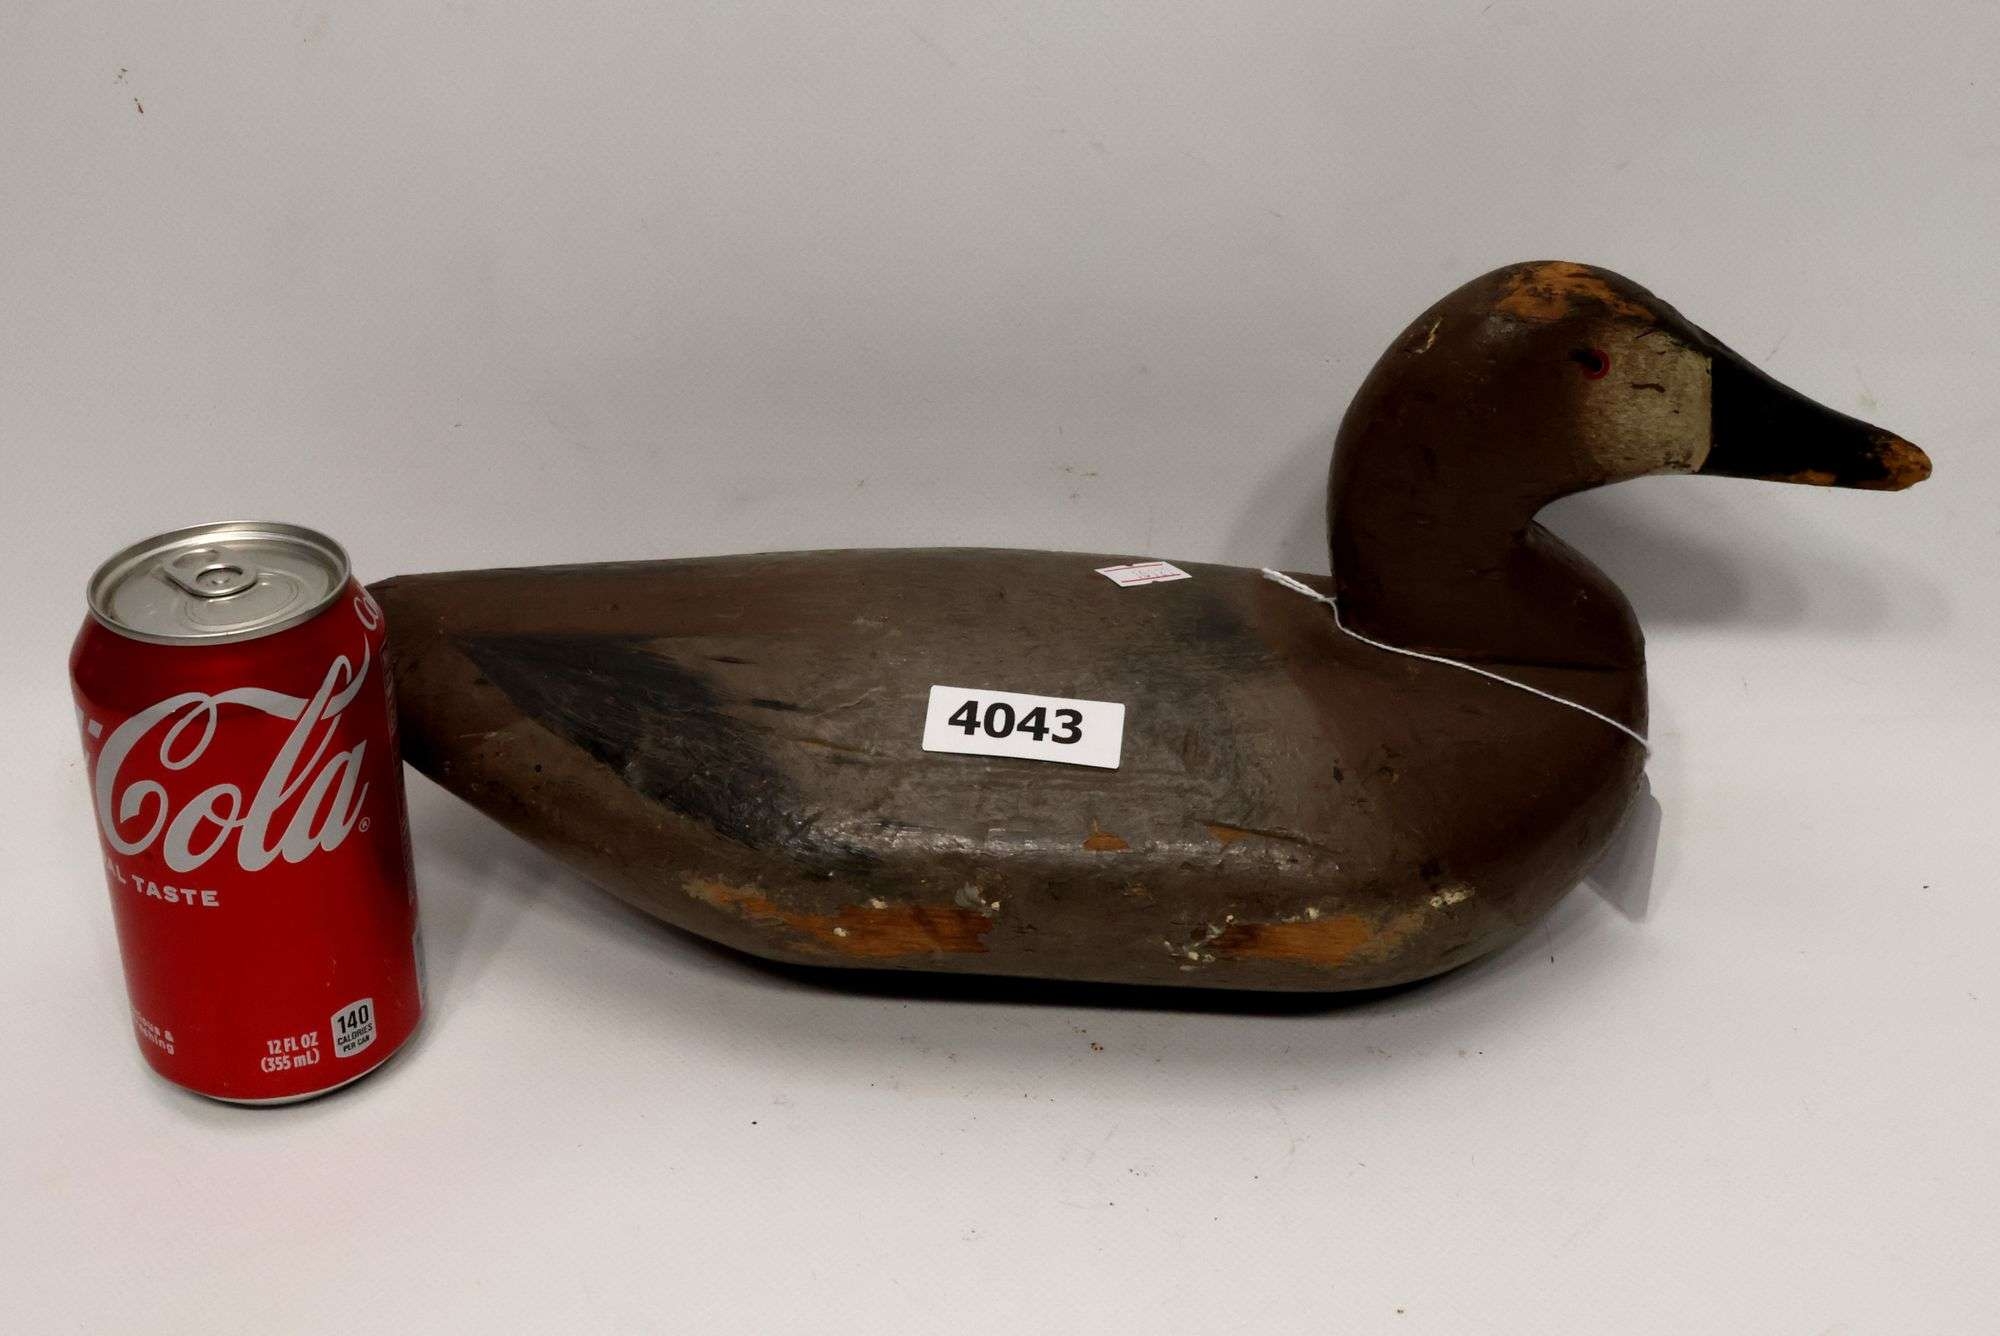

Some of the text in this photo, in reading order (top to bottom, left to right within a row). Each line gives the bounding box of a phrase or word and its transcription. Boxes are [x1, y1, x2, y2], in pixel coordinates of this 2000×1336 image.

[948, 700, 1083, 744] 4043
[96, 632, 370, 873] Cola
[131, 873, 220, 907] TASTE
[337, 1004, 370, 1034] 140
[266, 1031, 319, 1055] 12 FL OZ
[337, 1022, 373, 1046] CALORIES
[343, 1034, 370, 1052] PER CAN
[260, 1047, 320, 1073] (355 mL)
